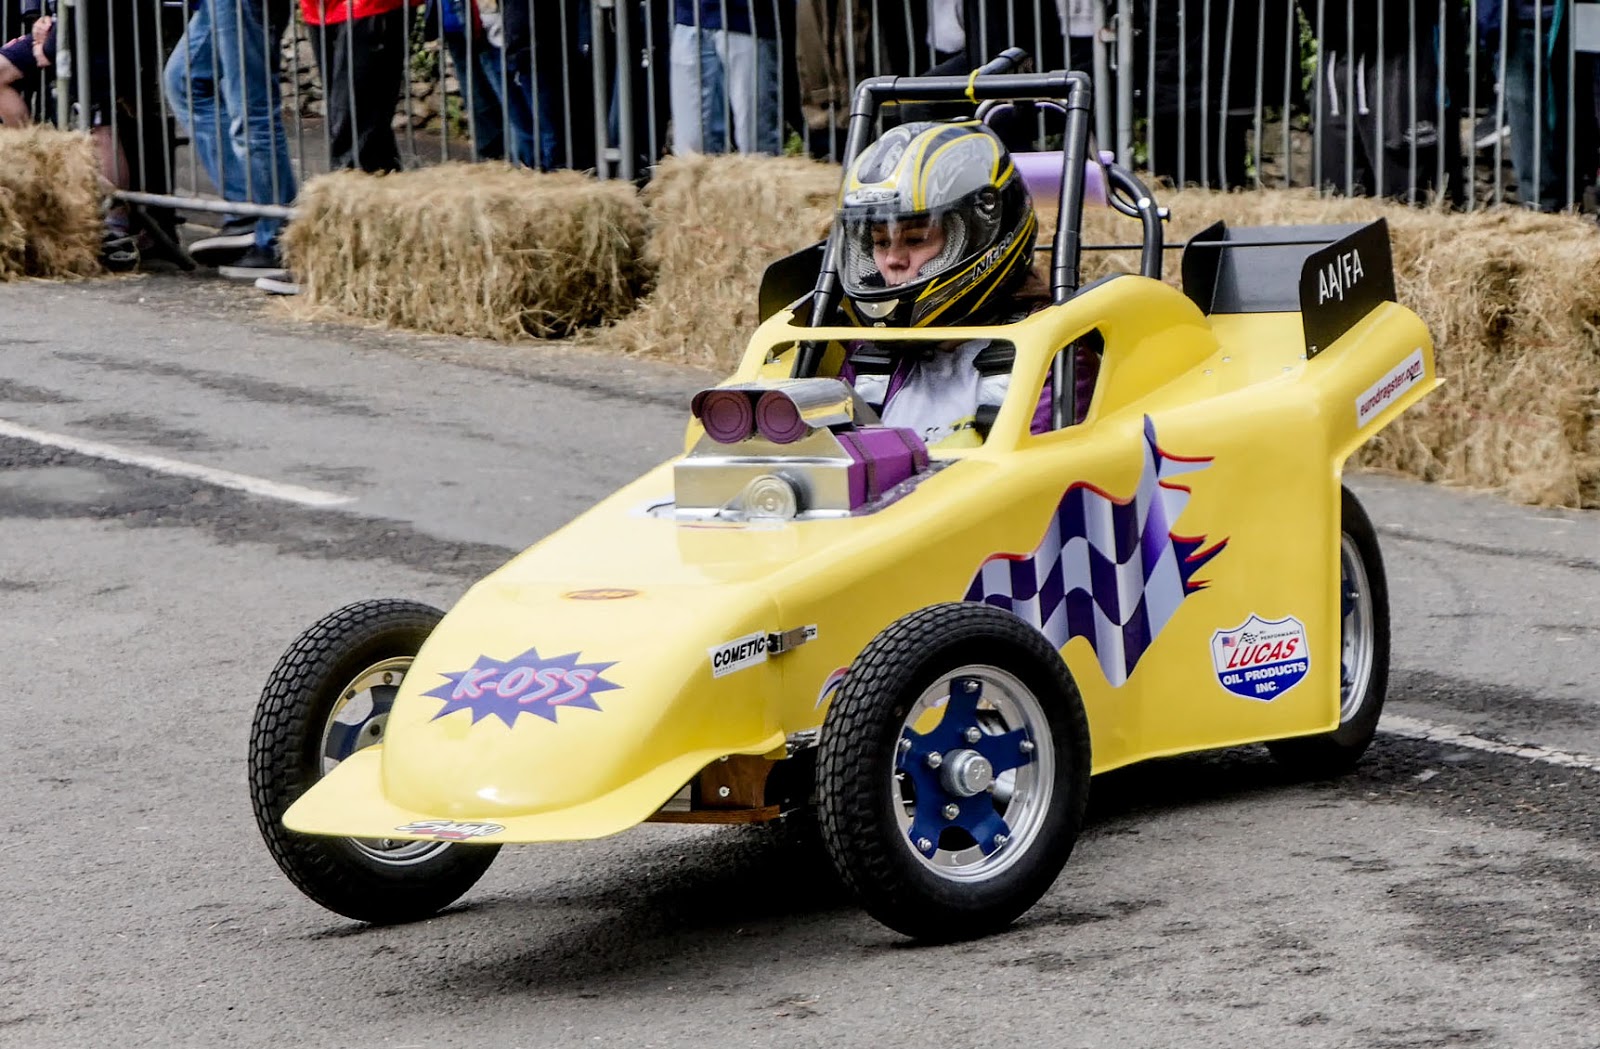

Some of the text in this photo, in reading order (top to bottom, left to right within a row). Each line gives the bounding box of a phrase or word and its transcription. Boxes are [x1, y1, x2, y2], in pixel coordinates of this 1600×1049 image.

[1319, 248, 1364, 305] AA/FA
[1360, 359, 1420, 416] eurodragster.com
[713, 636, 765, 669] COMETIC
[1226, 637, 1299, 669] LUCAS
[452, 665, 598, 706] K-OSS
[1222, 661, 1306, 686] OIL PRODUCTS
